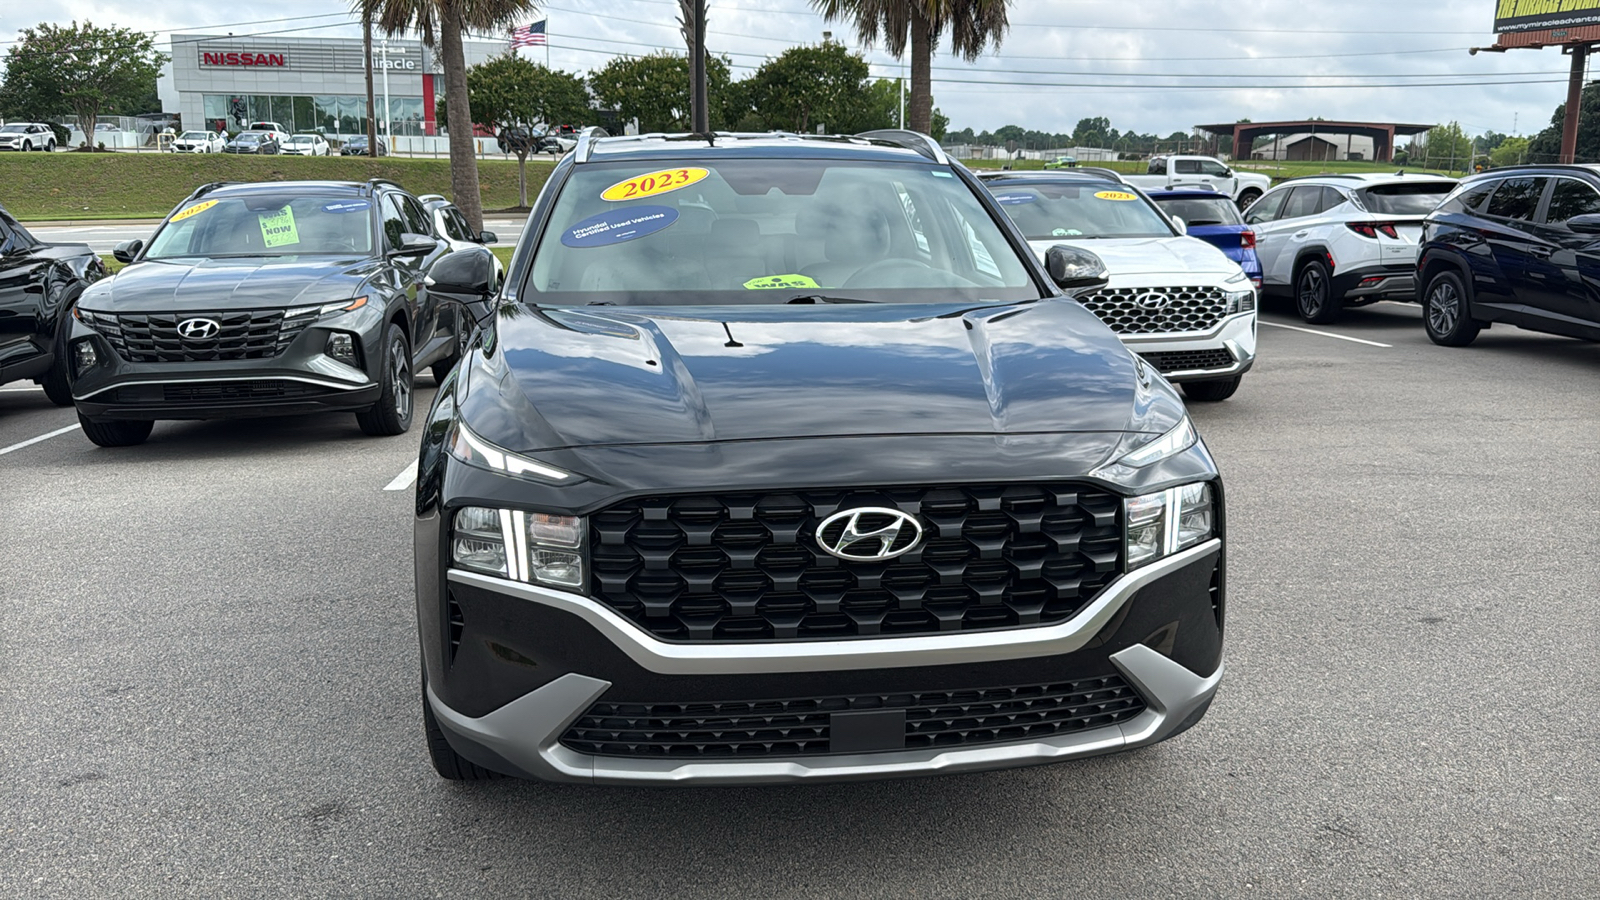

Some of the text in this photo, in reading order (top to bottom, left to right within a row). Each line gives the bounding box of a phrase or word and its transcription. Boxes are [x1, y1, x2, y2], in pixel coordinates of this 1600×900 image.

[1496, 0, 1517, 19] THE
[203, 52, 284, 66] NISSAN
[623, 169, 689, 198] 2023
[1103, 191, 1130, 199] 2023
[265, 225, 291, 235] NOW
[572, 221, 608, 235] Hyundai
[575, 225, 610, 239] Certified
[610, 219, 632, 230] Used
[631, 212, 665, 224] Vehicles
